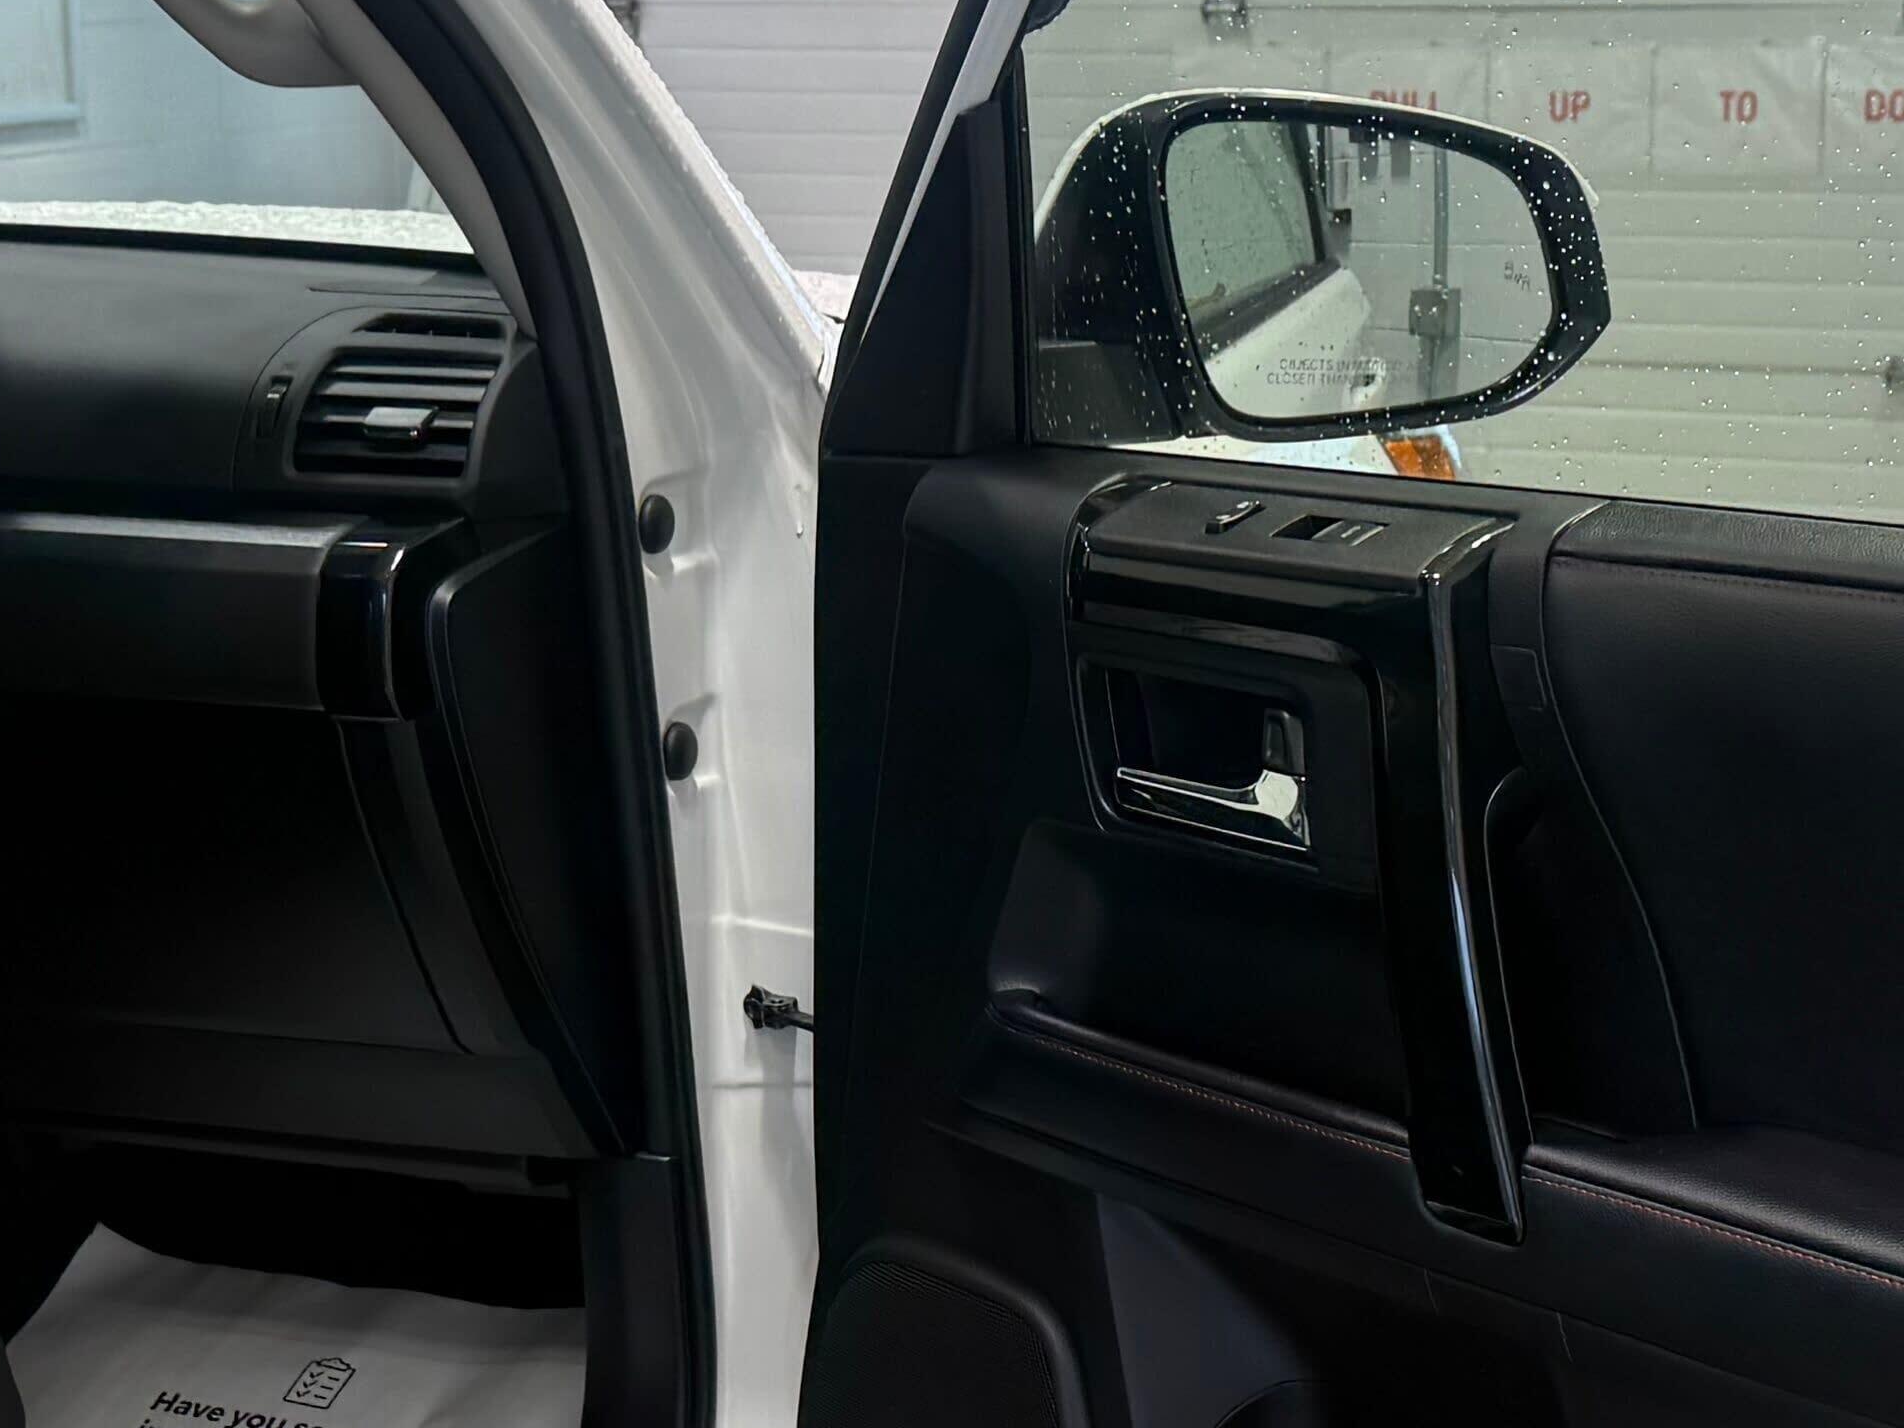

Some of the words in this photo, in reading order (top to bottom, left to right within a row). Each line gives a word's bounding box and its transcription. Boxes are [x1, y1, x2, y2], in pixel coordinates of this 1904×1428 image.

[1549, 90, 1591, 123] UP
[1720, 90, 1758, 123] TO
[150, 1391, 225, 1422] Have
